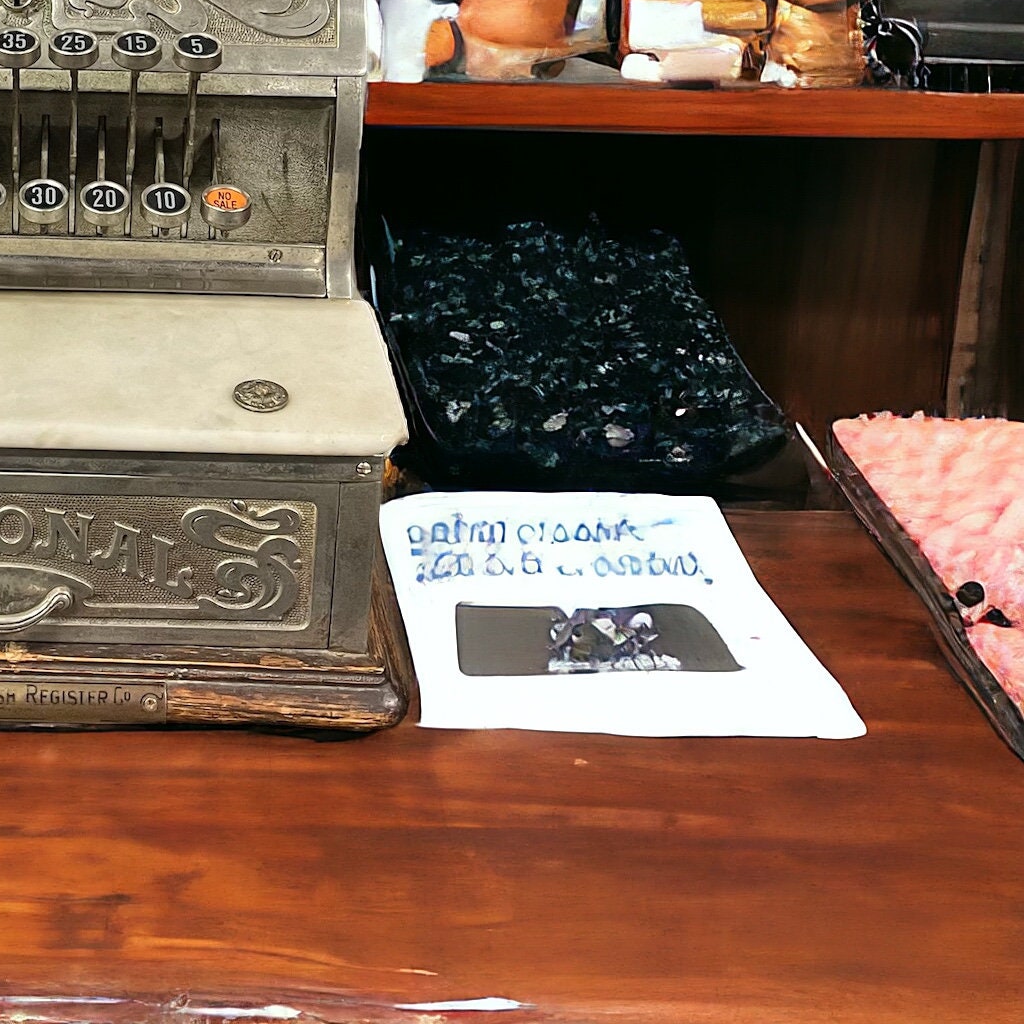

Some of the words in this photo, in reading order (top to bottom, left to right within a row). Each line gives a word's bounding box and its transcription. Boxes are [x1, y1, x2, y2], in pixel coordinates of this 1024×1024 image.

[2, 33, 26, 49] 35
[61, 35, 86, 50] 25
[125, 35, 148, 50] 15
[191, 38, 203, 54] 5
[31, 186, 57, 205] 30
[92, 189, 117, 208] 20
[154, 191, 176, 209] 10
[218, 191, 232, 200] NO
[213, 199, 237, 209] SALE
[26, 684, 108, 705] REGISTER
